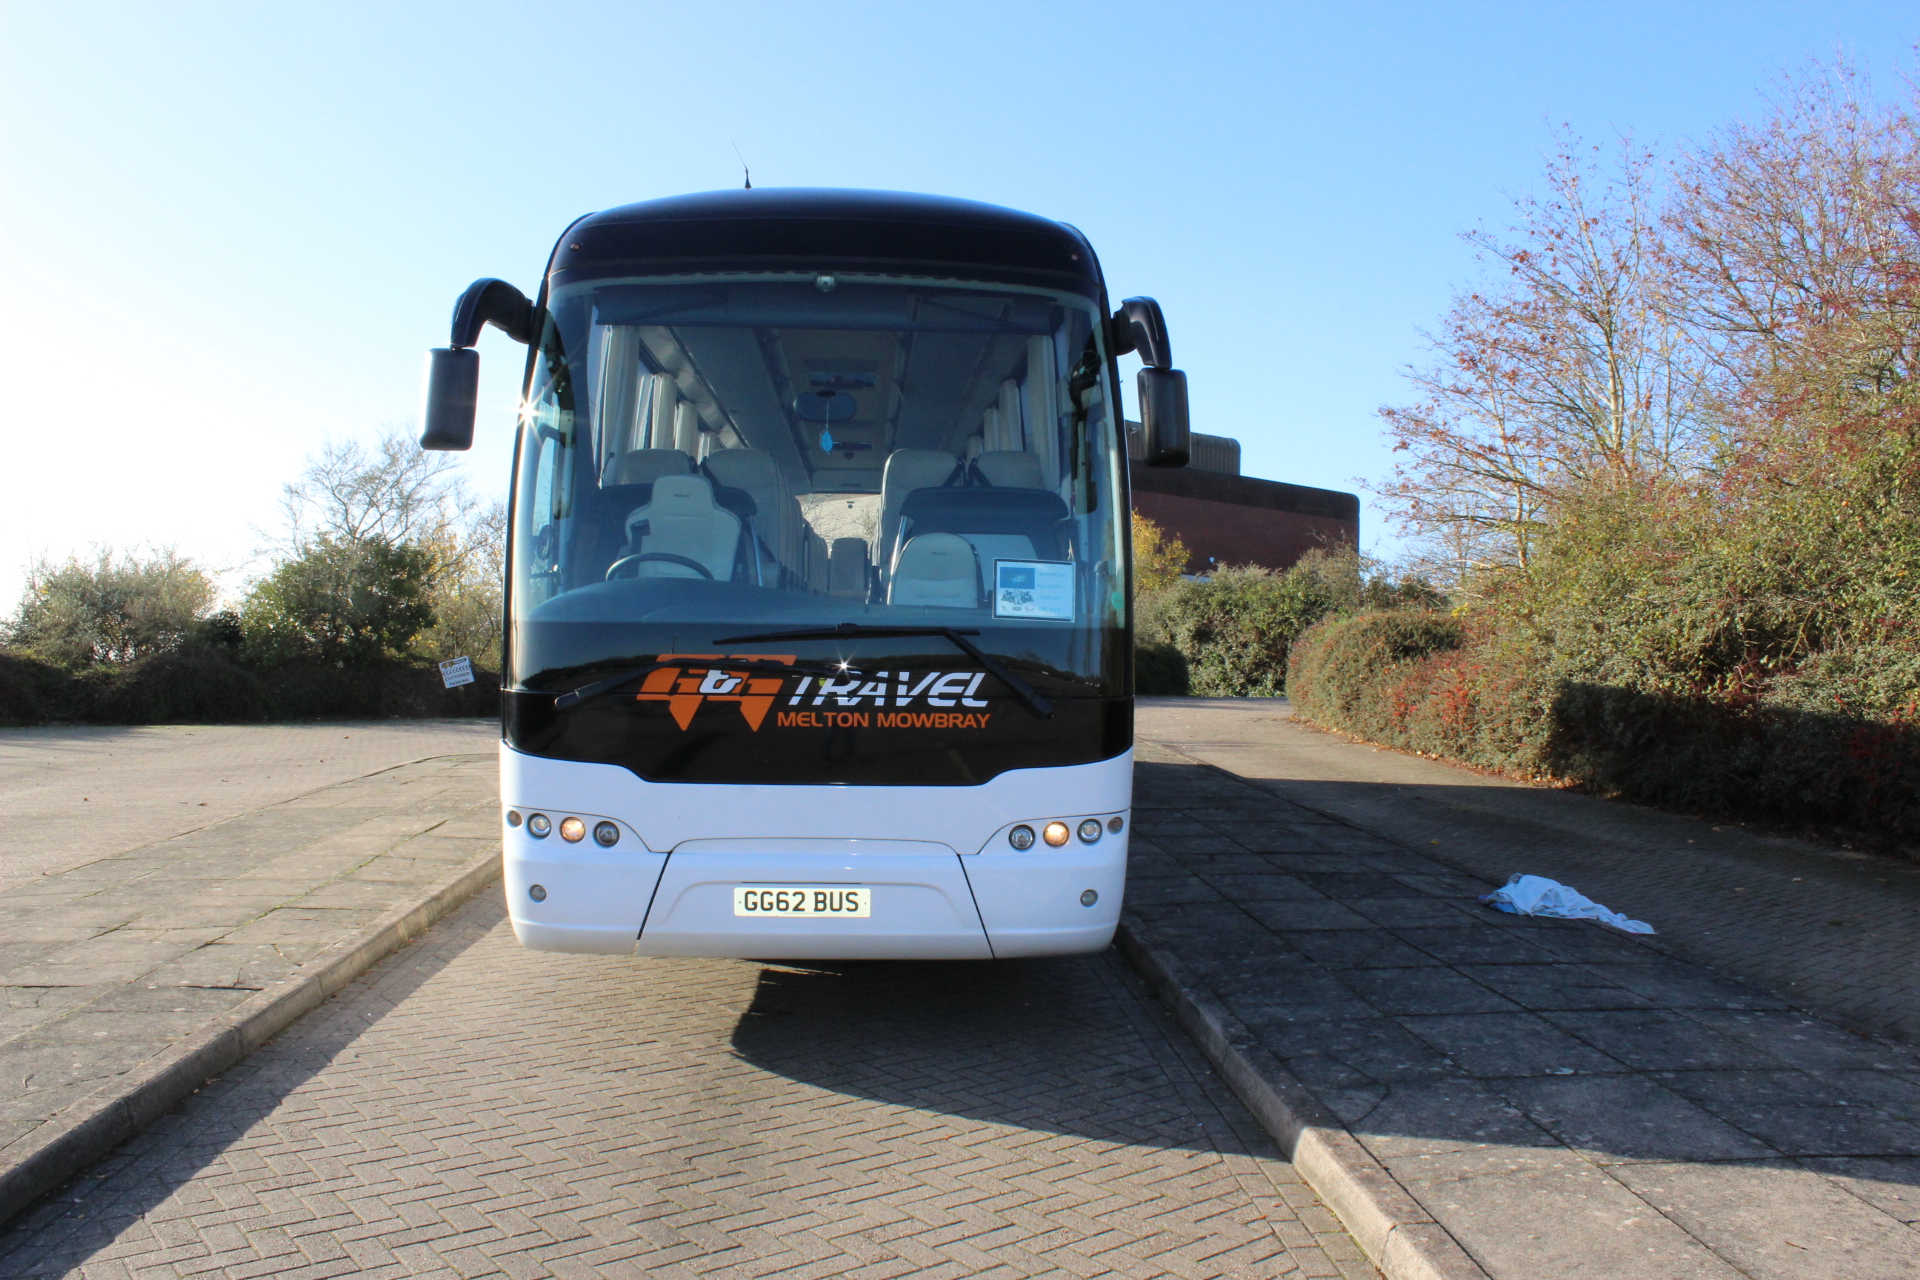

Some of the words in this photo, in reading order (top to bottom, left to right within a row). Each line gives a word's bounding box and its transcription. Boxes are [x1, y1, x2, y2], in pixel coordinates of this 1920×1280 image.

[445, 672, 470, 681] CUSTOMER
[449, 678, 470, 686] PARKING
[788, 671, 989, 707] TRAVEL
[777, 712, 870, 728] MELTON
[877, 712, 991, 729] MOWBRAY
[744, 890, 806, 912] GG62
[813, 891, 859, 912] BUS
